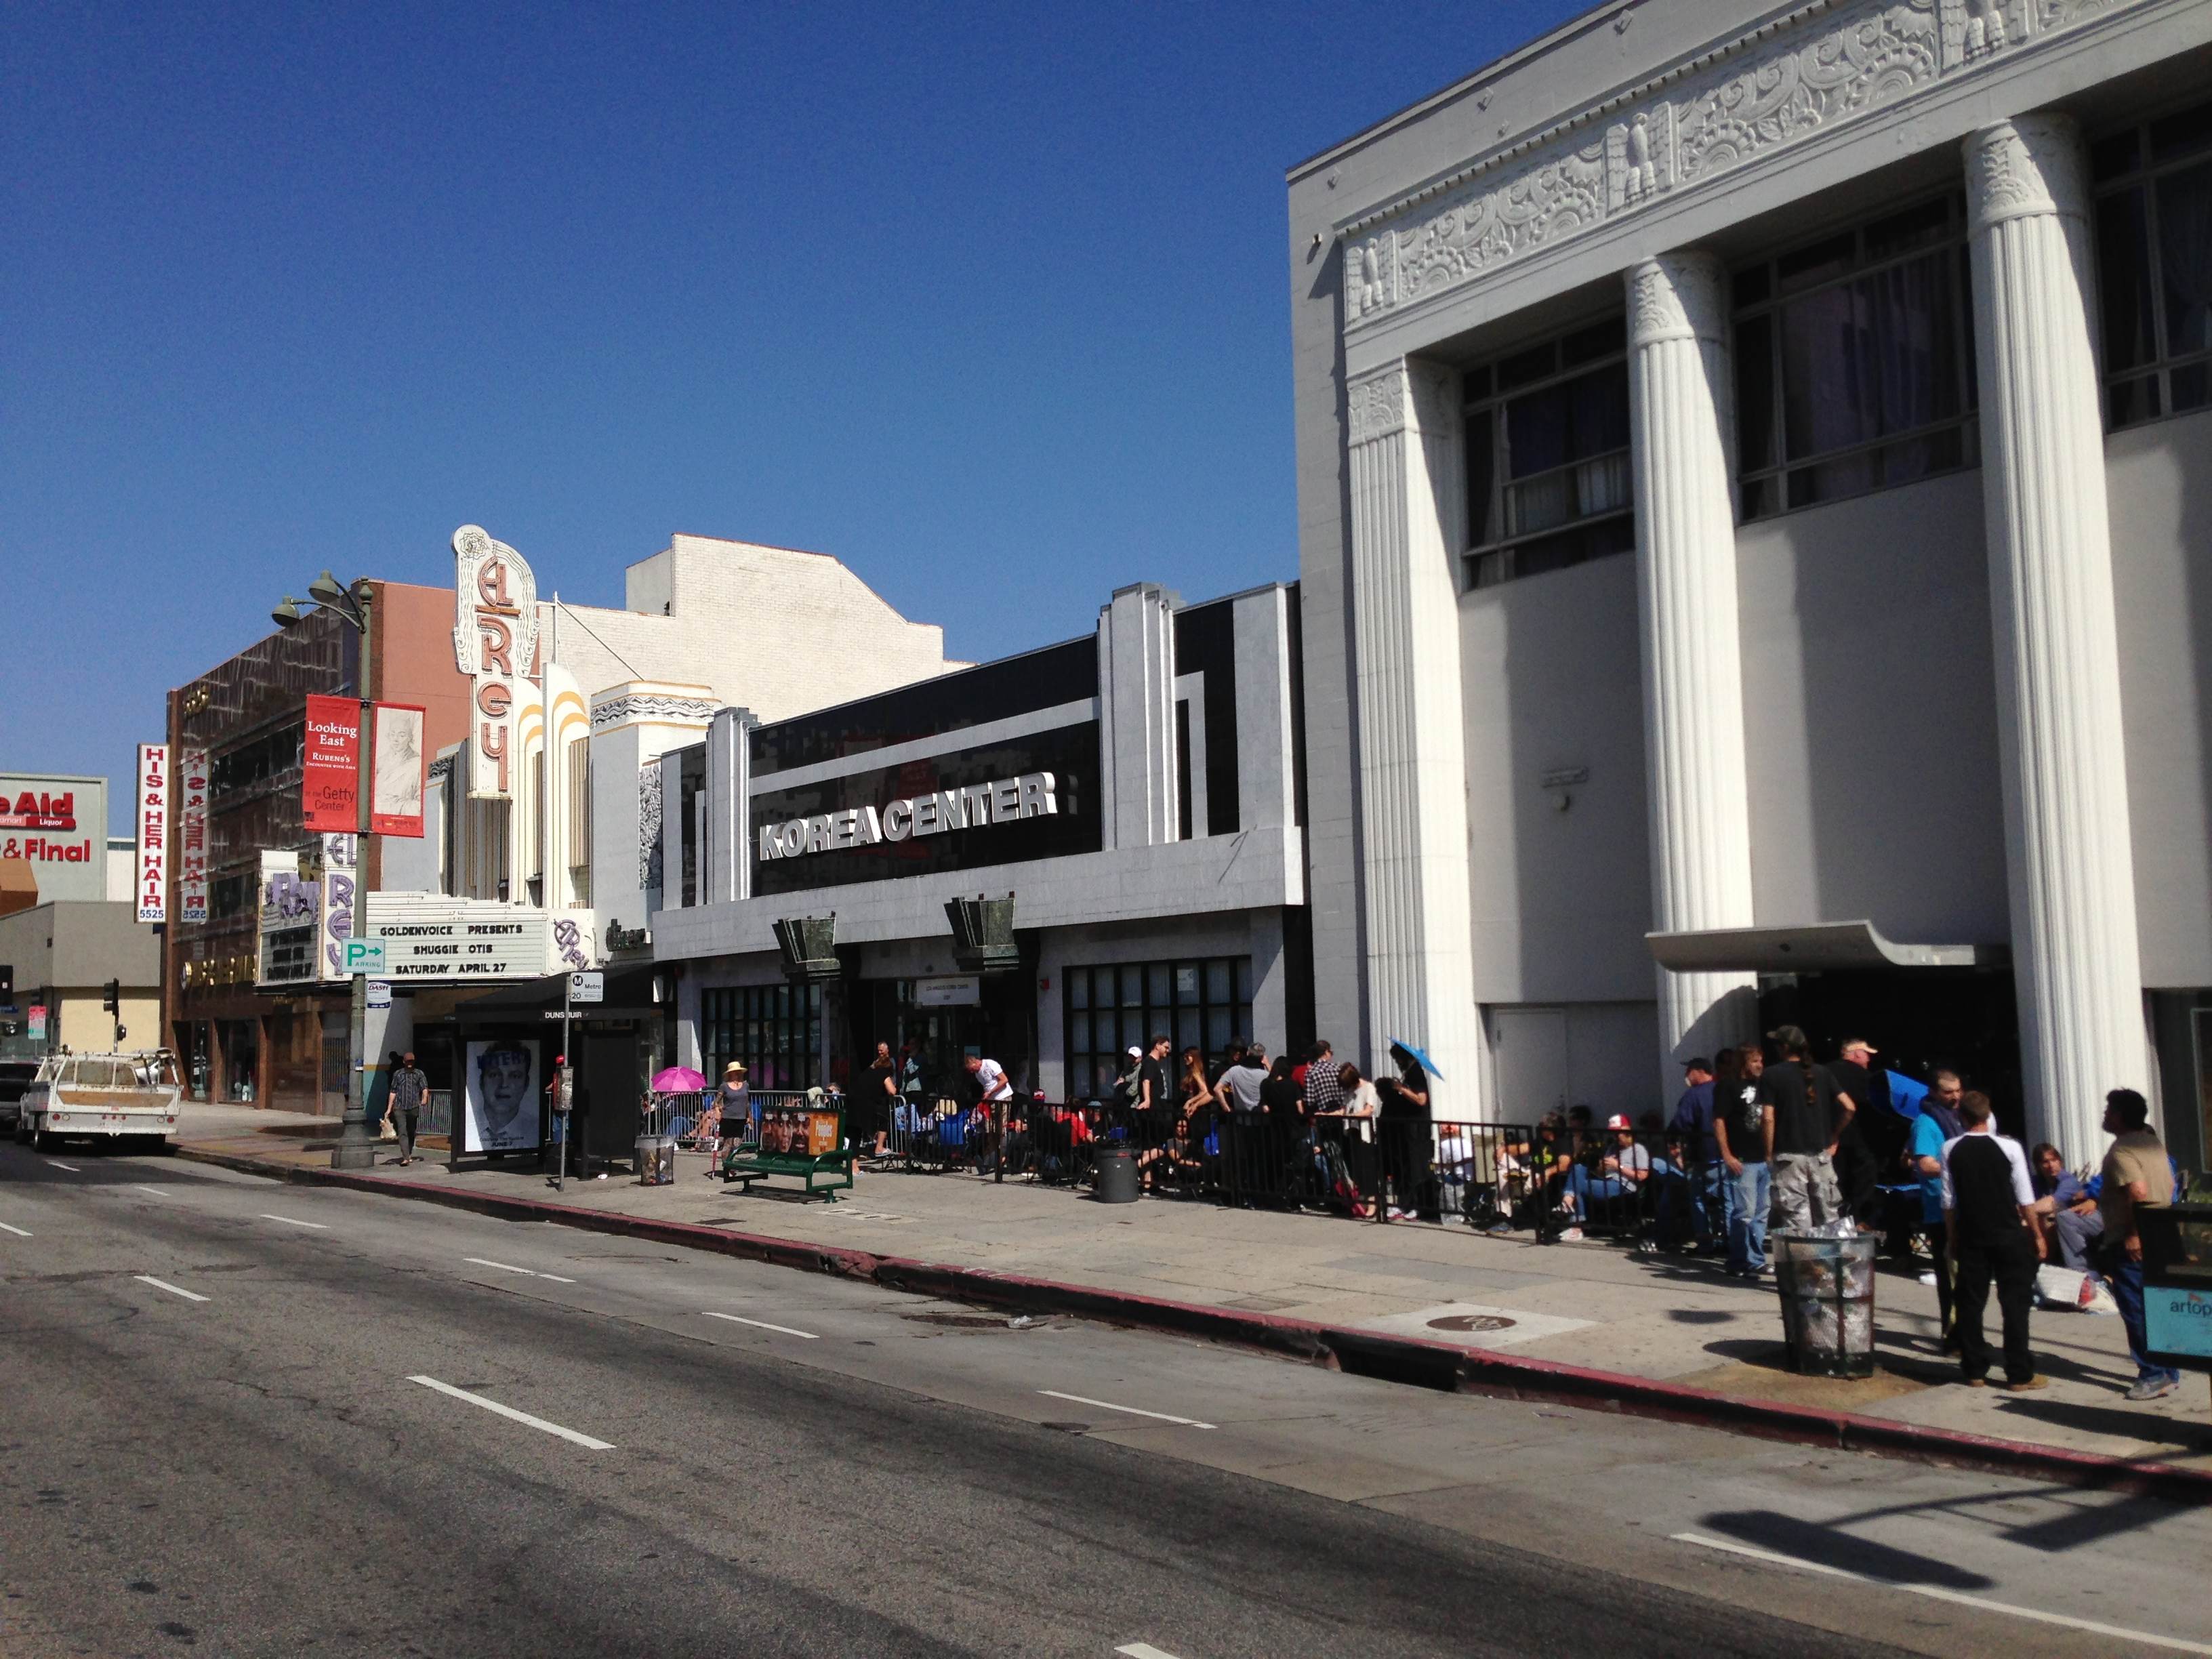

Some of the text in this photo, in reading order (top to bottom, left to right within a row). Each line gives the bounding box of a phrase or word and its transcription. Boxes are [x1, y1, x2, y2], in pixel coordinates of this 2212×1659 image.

[308, 720, 357, 739] Looking
[320, 734, 345, 746] East
[323, 785, 354, 803] Getty
[14, 792, 73, 816] Aid
[314, 800, 345, 811] Center
[760, 772, 1058, 861] KOREA CENTER
[143, 748, 164, 908] HIS & HER HAIR
[3, 838, 90, 862] & Final
[140, 909, 165, 919] 5525
[380, 924, 523, 937] GOLDENVOICE PRESENTS
[413, 944, 493, 955] SHUGGIE OTIS
[395, 962, 507, 975] SATURDAY APRIL 27
[2170, 1301, 2212, 1318] artop
